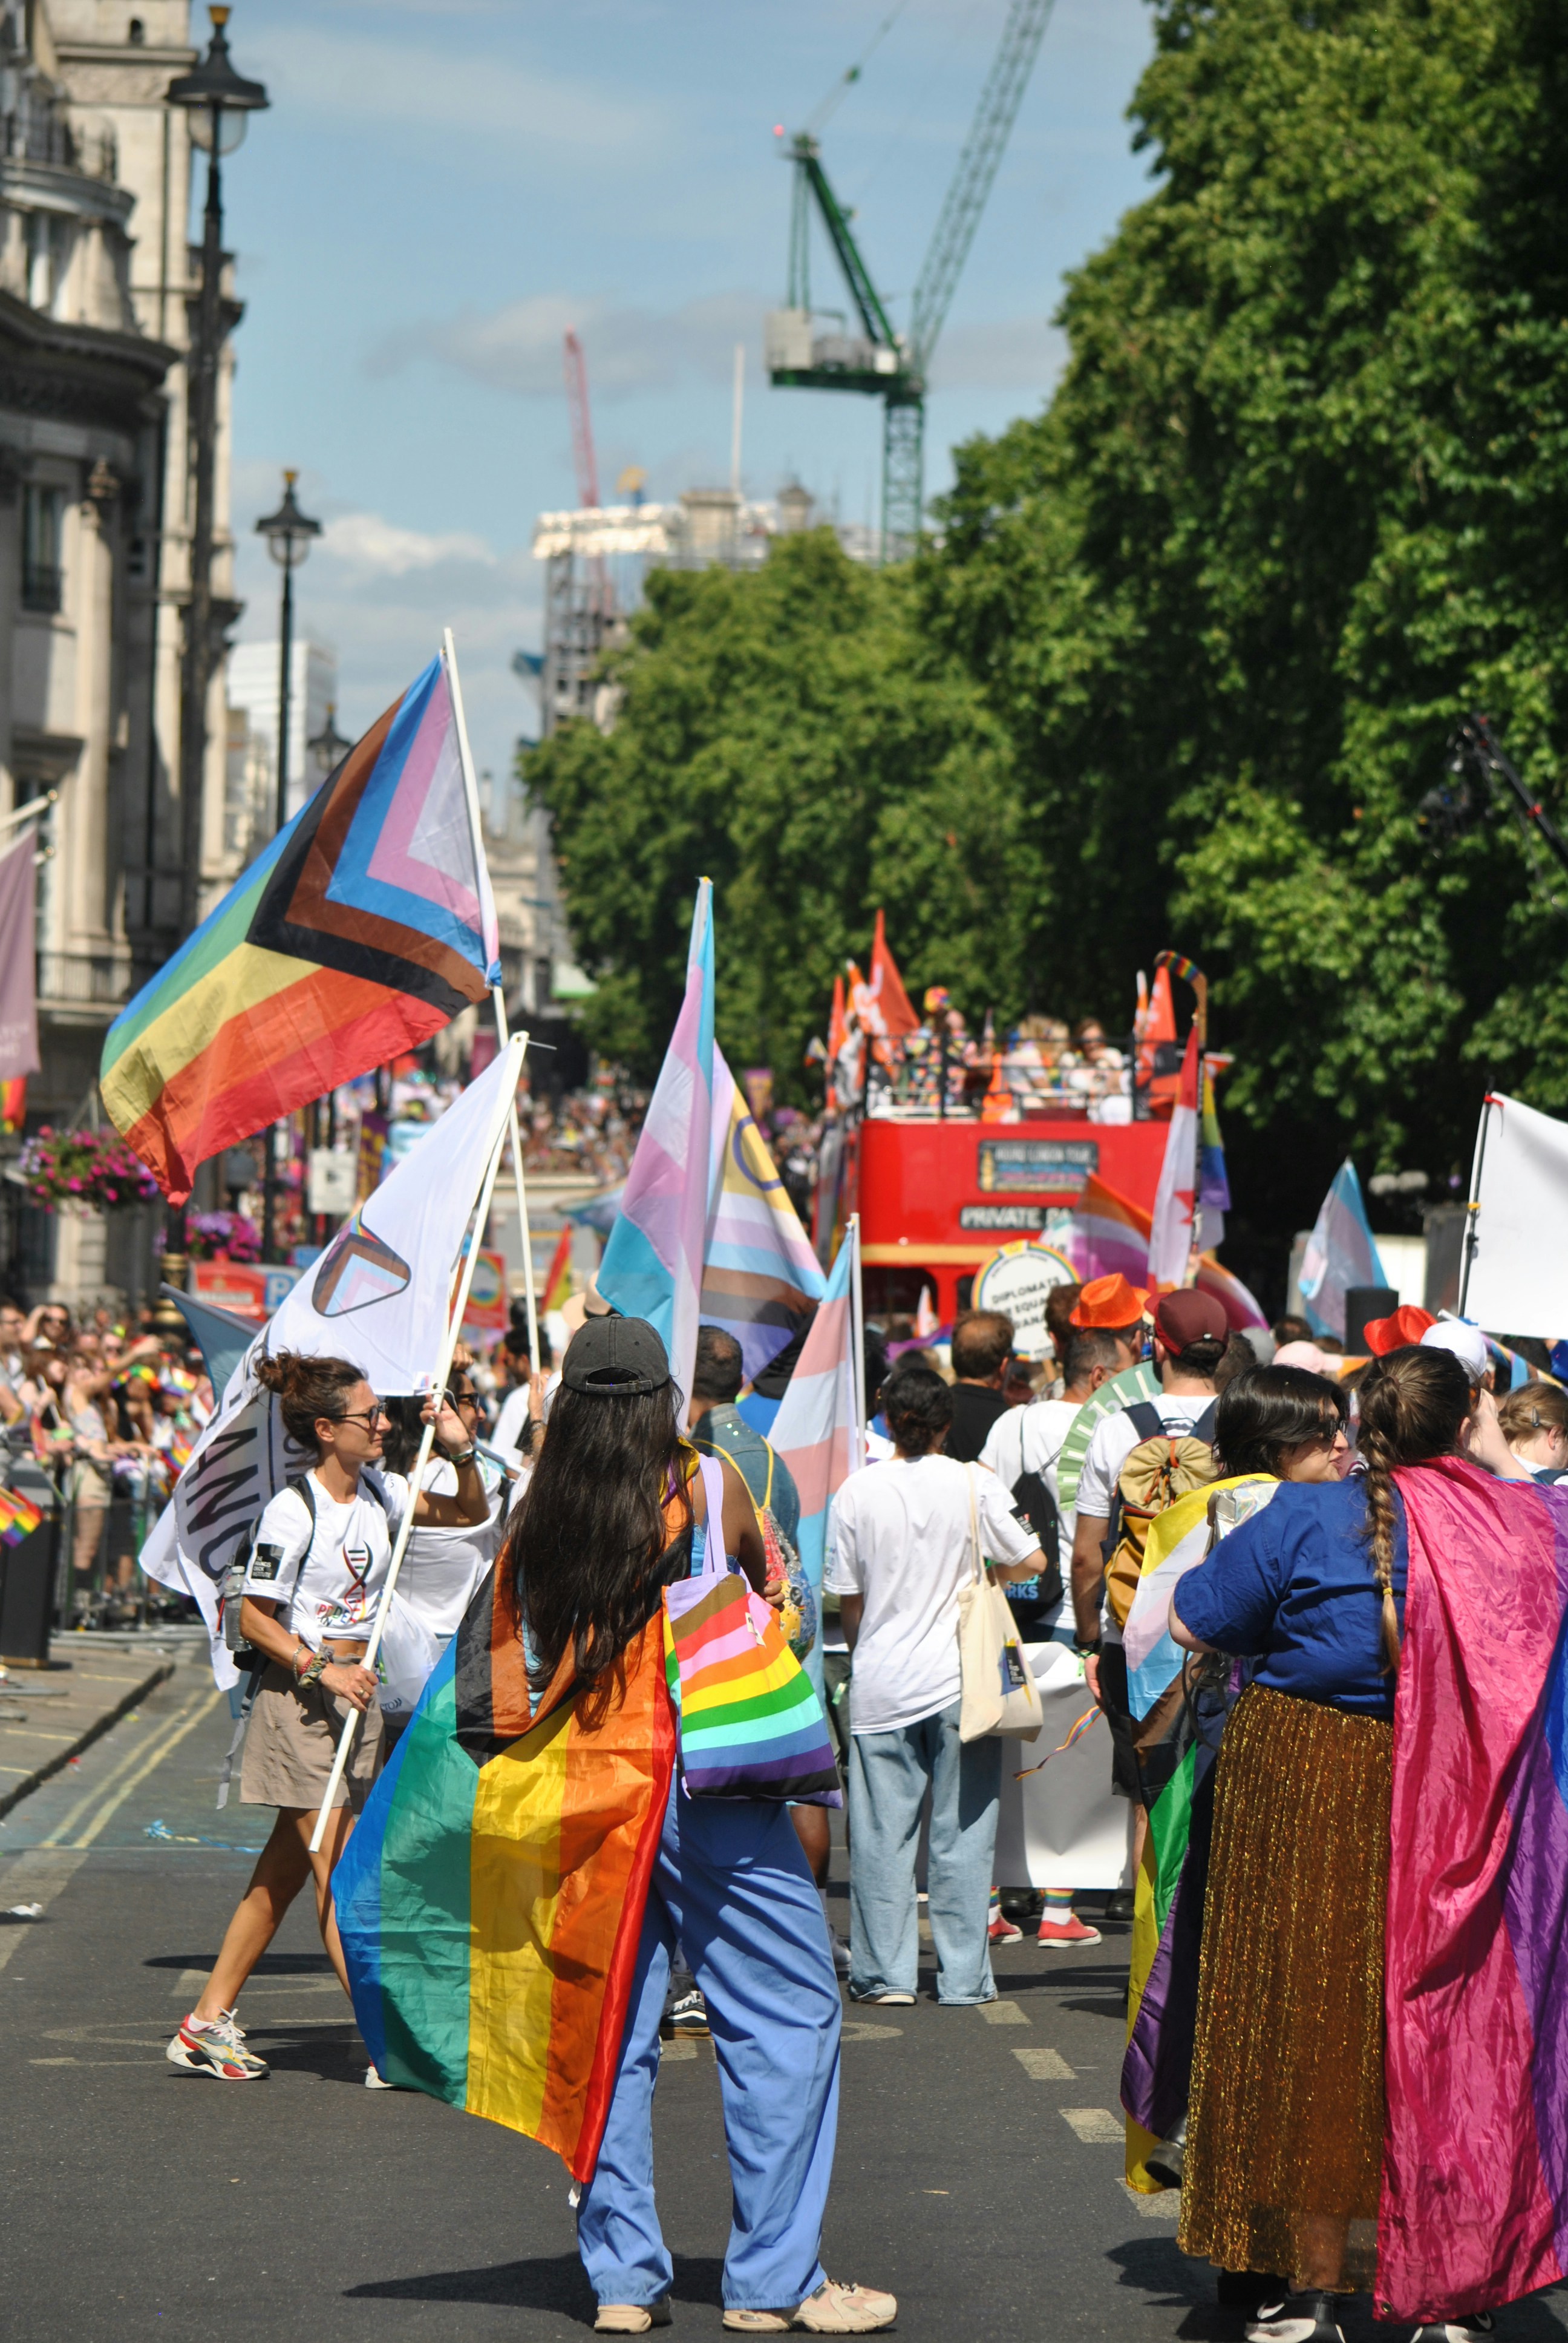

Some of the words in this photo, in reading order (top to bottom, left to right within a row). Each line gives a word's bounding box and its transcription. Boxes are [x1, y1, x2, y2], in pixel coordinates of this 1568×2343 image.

[961, 1207, 1042, 1228] PRIVATE
[1045, 1207, 1074, 1228] PA
[270, 1277, 292, 1307] P
[992, 1277, 1060, 1304] DIPLOMATS
[1015, 1297, 1048, 1314] EQUA
[1005, 1584, 1039, 1599] RKS
[316, 1604, 350, 1624] PDE
